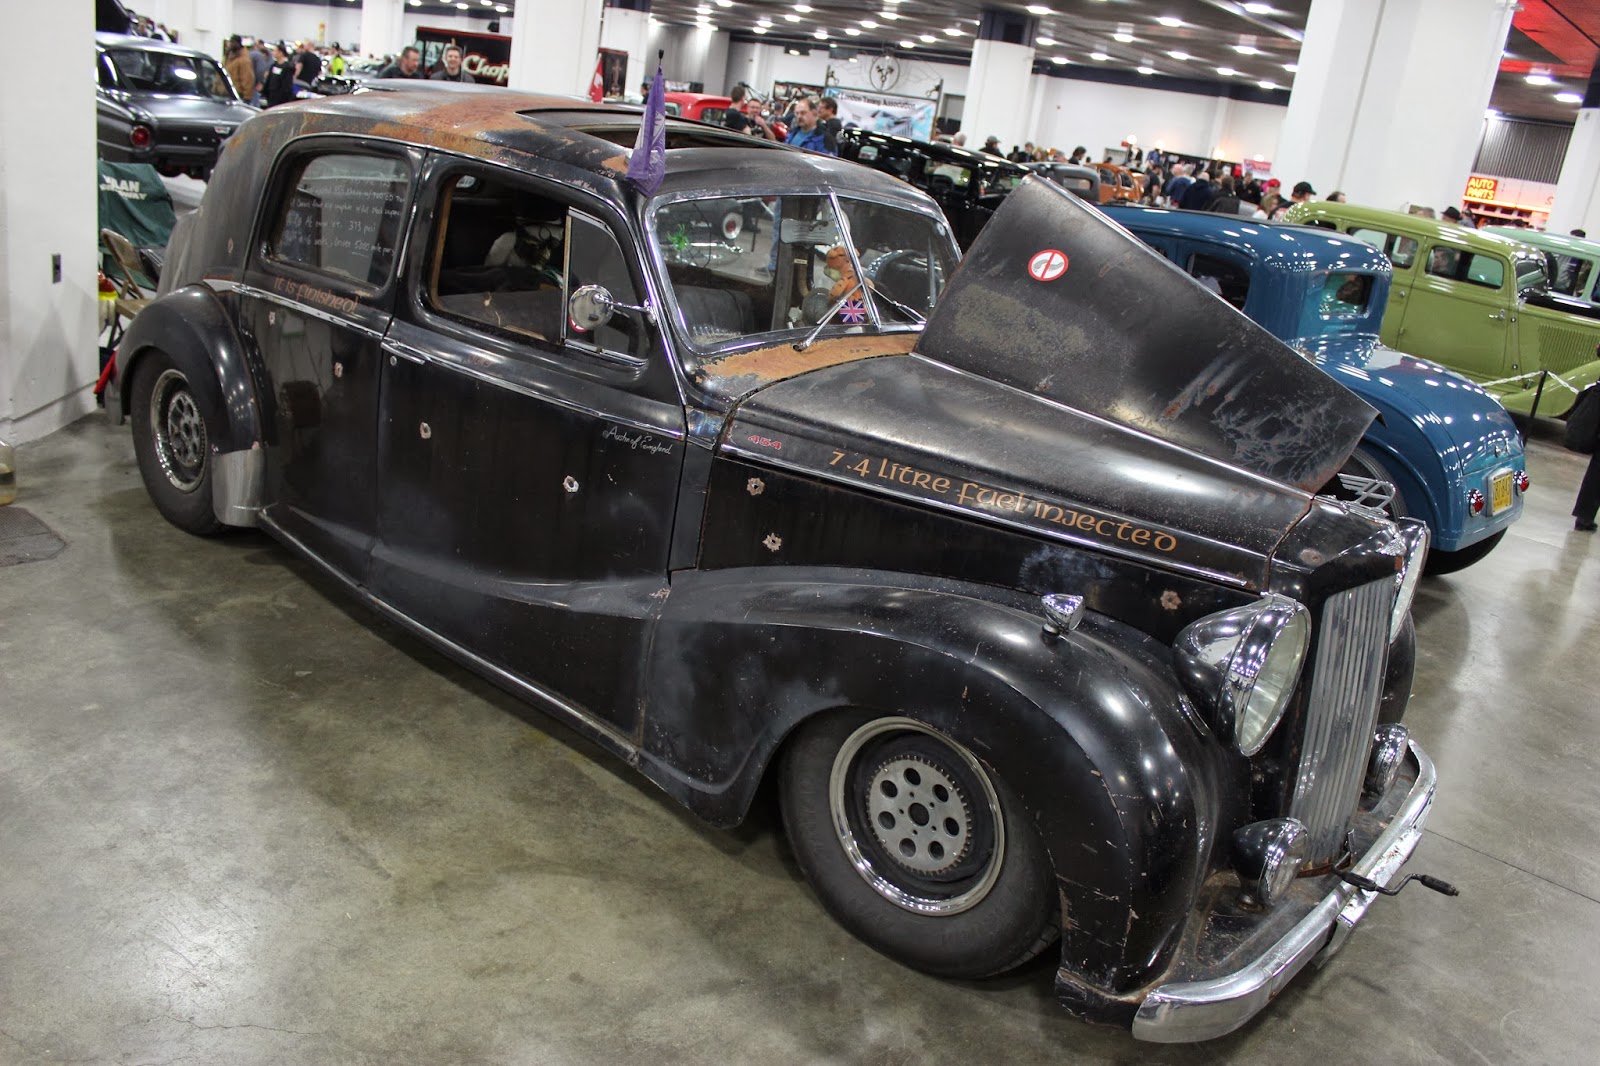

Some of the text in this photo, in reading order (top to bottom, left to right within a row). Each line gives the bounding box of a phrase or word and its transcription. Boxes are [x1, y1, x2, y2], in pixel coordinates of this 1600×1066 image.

[1468, 178, 1494, 190] AUTO
[1466, 187, 1494, 200] PARTS
[629, 435, 642, 450] of
[640, 436, 672, 455] England
[747, 434, 782, 451] 454
[828, 450, 1178, 552] 7.4 litre fuel injected
